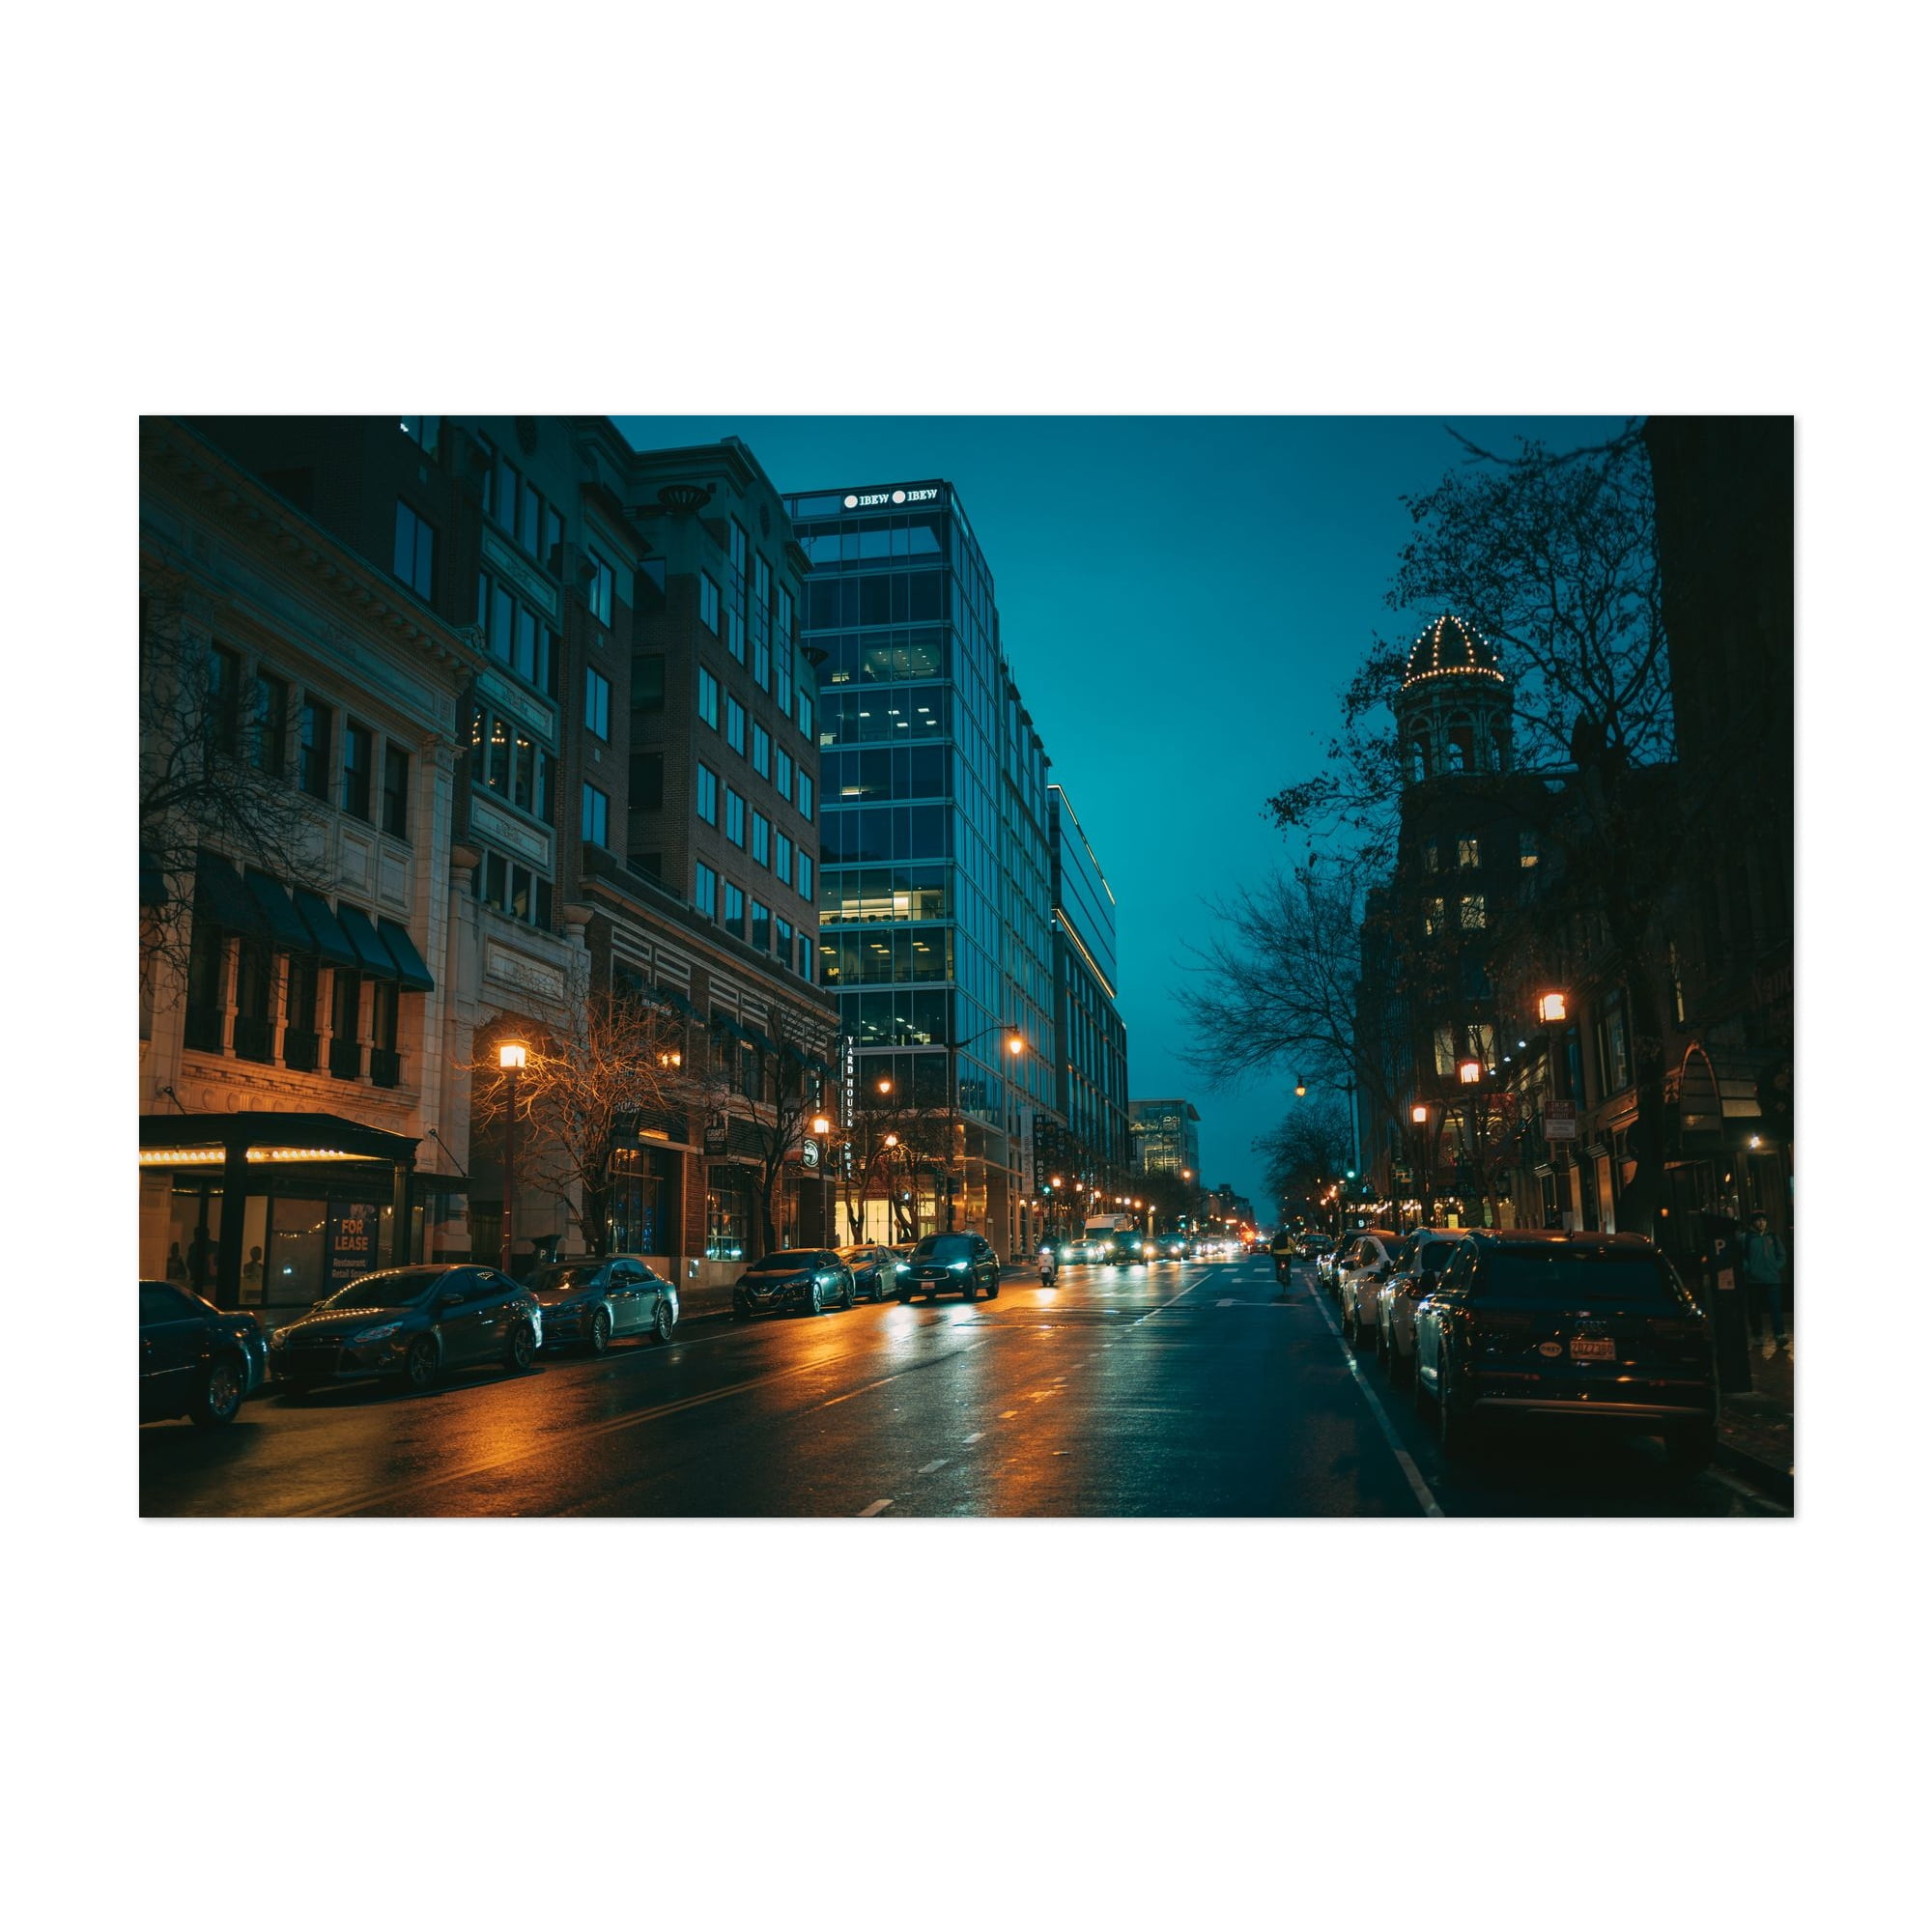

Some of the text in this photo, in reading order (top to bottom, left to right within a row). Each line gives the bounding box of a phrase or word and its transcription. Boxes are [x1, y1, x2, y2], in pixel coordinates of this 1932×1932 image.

[859, 489, 938, 506] IBEW IBEW
[341, 1219, 364, 1235] FOR
[334, 1236, 368, 1251] LEASE
[1715, 1238, 1726, 1256] P
